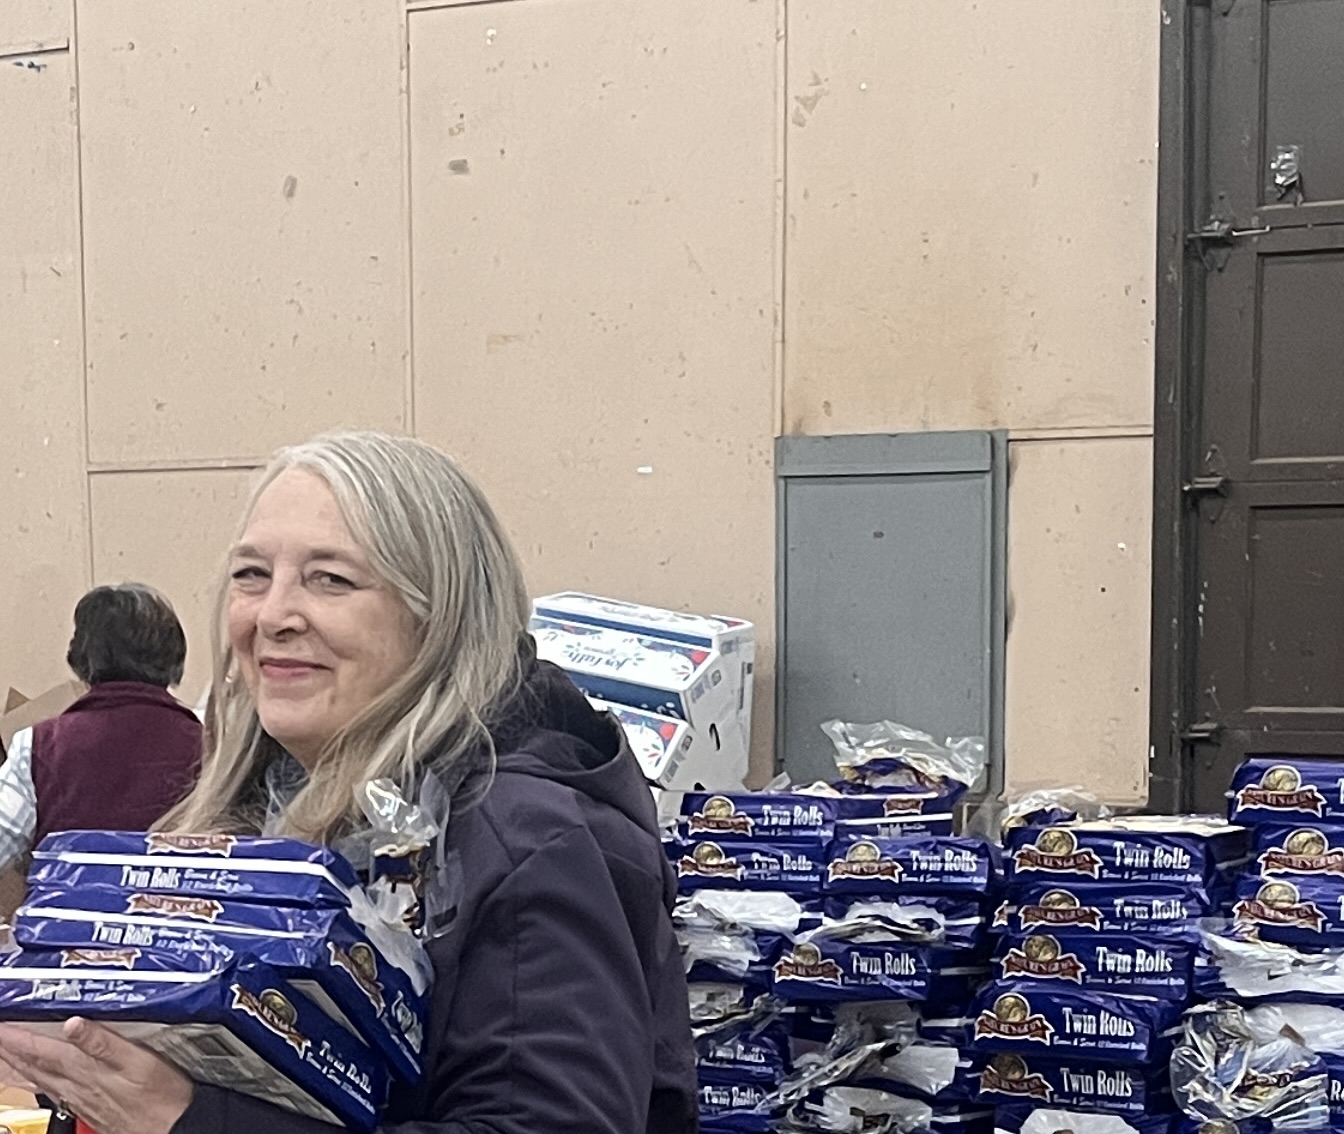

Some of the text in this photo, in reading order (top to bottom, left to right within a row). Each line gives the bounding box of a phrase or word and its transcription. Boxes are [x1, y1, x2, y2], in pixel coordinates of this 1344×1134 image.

[761, 805, 824, 826] Twin Rolls
[910, 849, 978, 872] Twin Rolls
[1113, 841, 1191, 870] Twin Rolls
[120, 865, 150, 888] Twin
[150, 867, 182, 889] Rolls
[91, 921, 154, 947] Twin Rolls
[851, 951, 916, 976] Twin Rolls
[1096, 946, 1132, 973] Twin
[1135, 949, 1173, 974] Rolls
[1062, 1007, 1096, 1035] Twin
[1060, 1067, 1133, 1097] Twin Rolls
